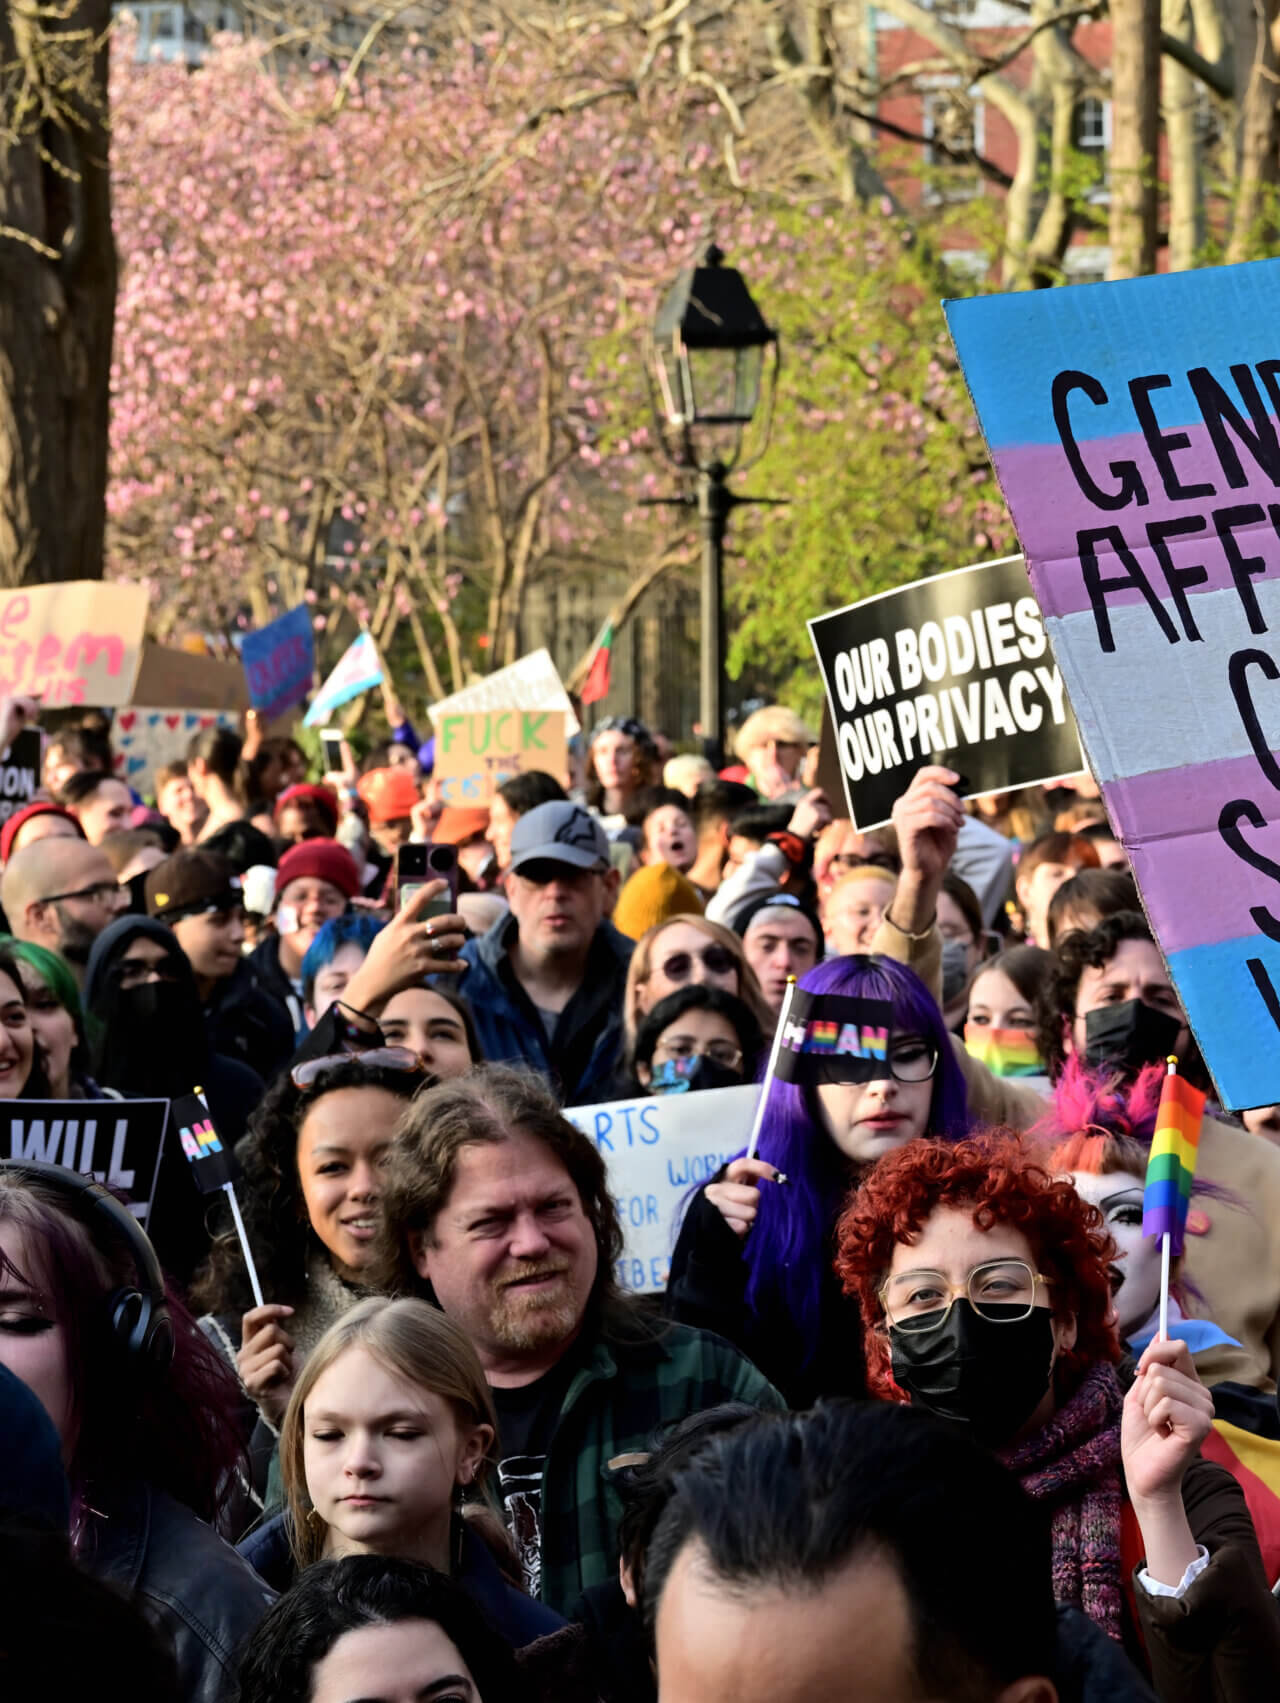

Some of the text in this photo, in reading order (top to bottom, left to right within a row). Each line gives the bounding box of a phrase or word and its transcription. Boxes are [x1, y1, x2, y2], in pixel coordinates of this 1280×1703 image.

[834, 597, 1047, 712] OUR BODIES
[442, 713, 550, 755] FUCK
[838, 664, 1067, 781] OUR PRIVACY
[10, 1119, 136, 1189] WILL
[572, 1105, 660, 1152] RTS
[615, 1194, 660, 1228] FOR
